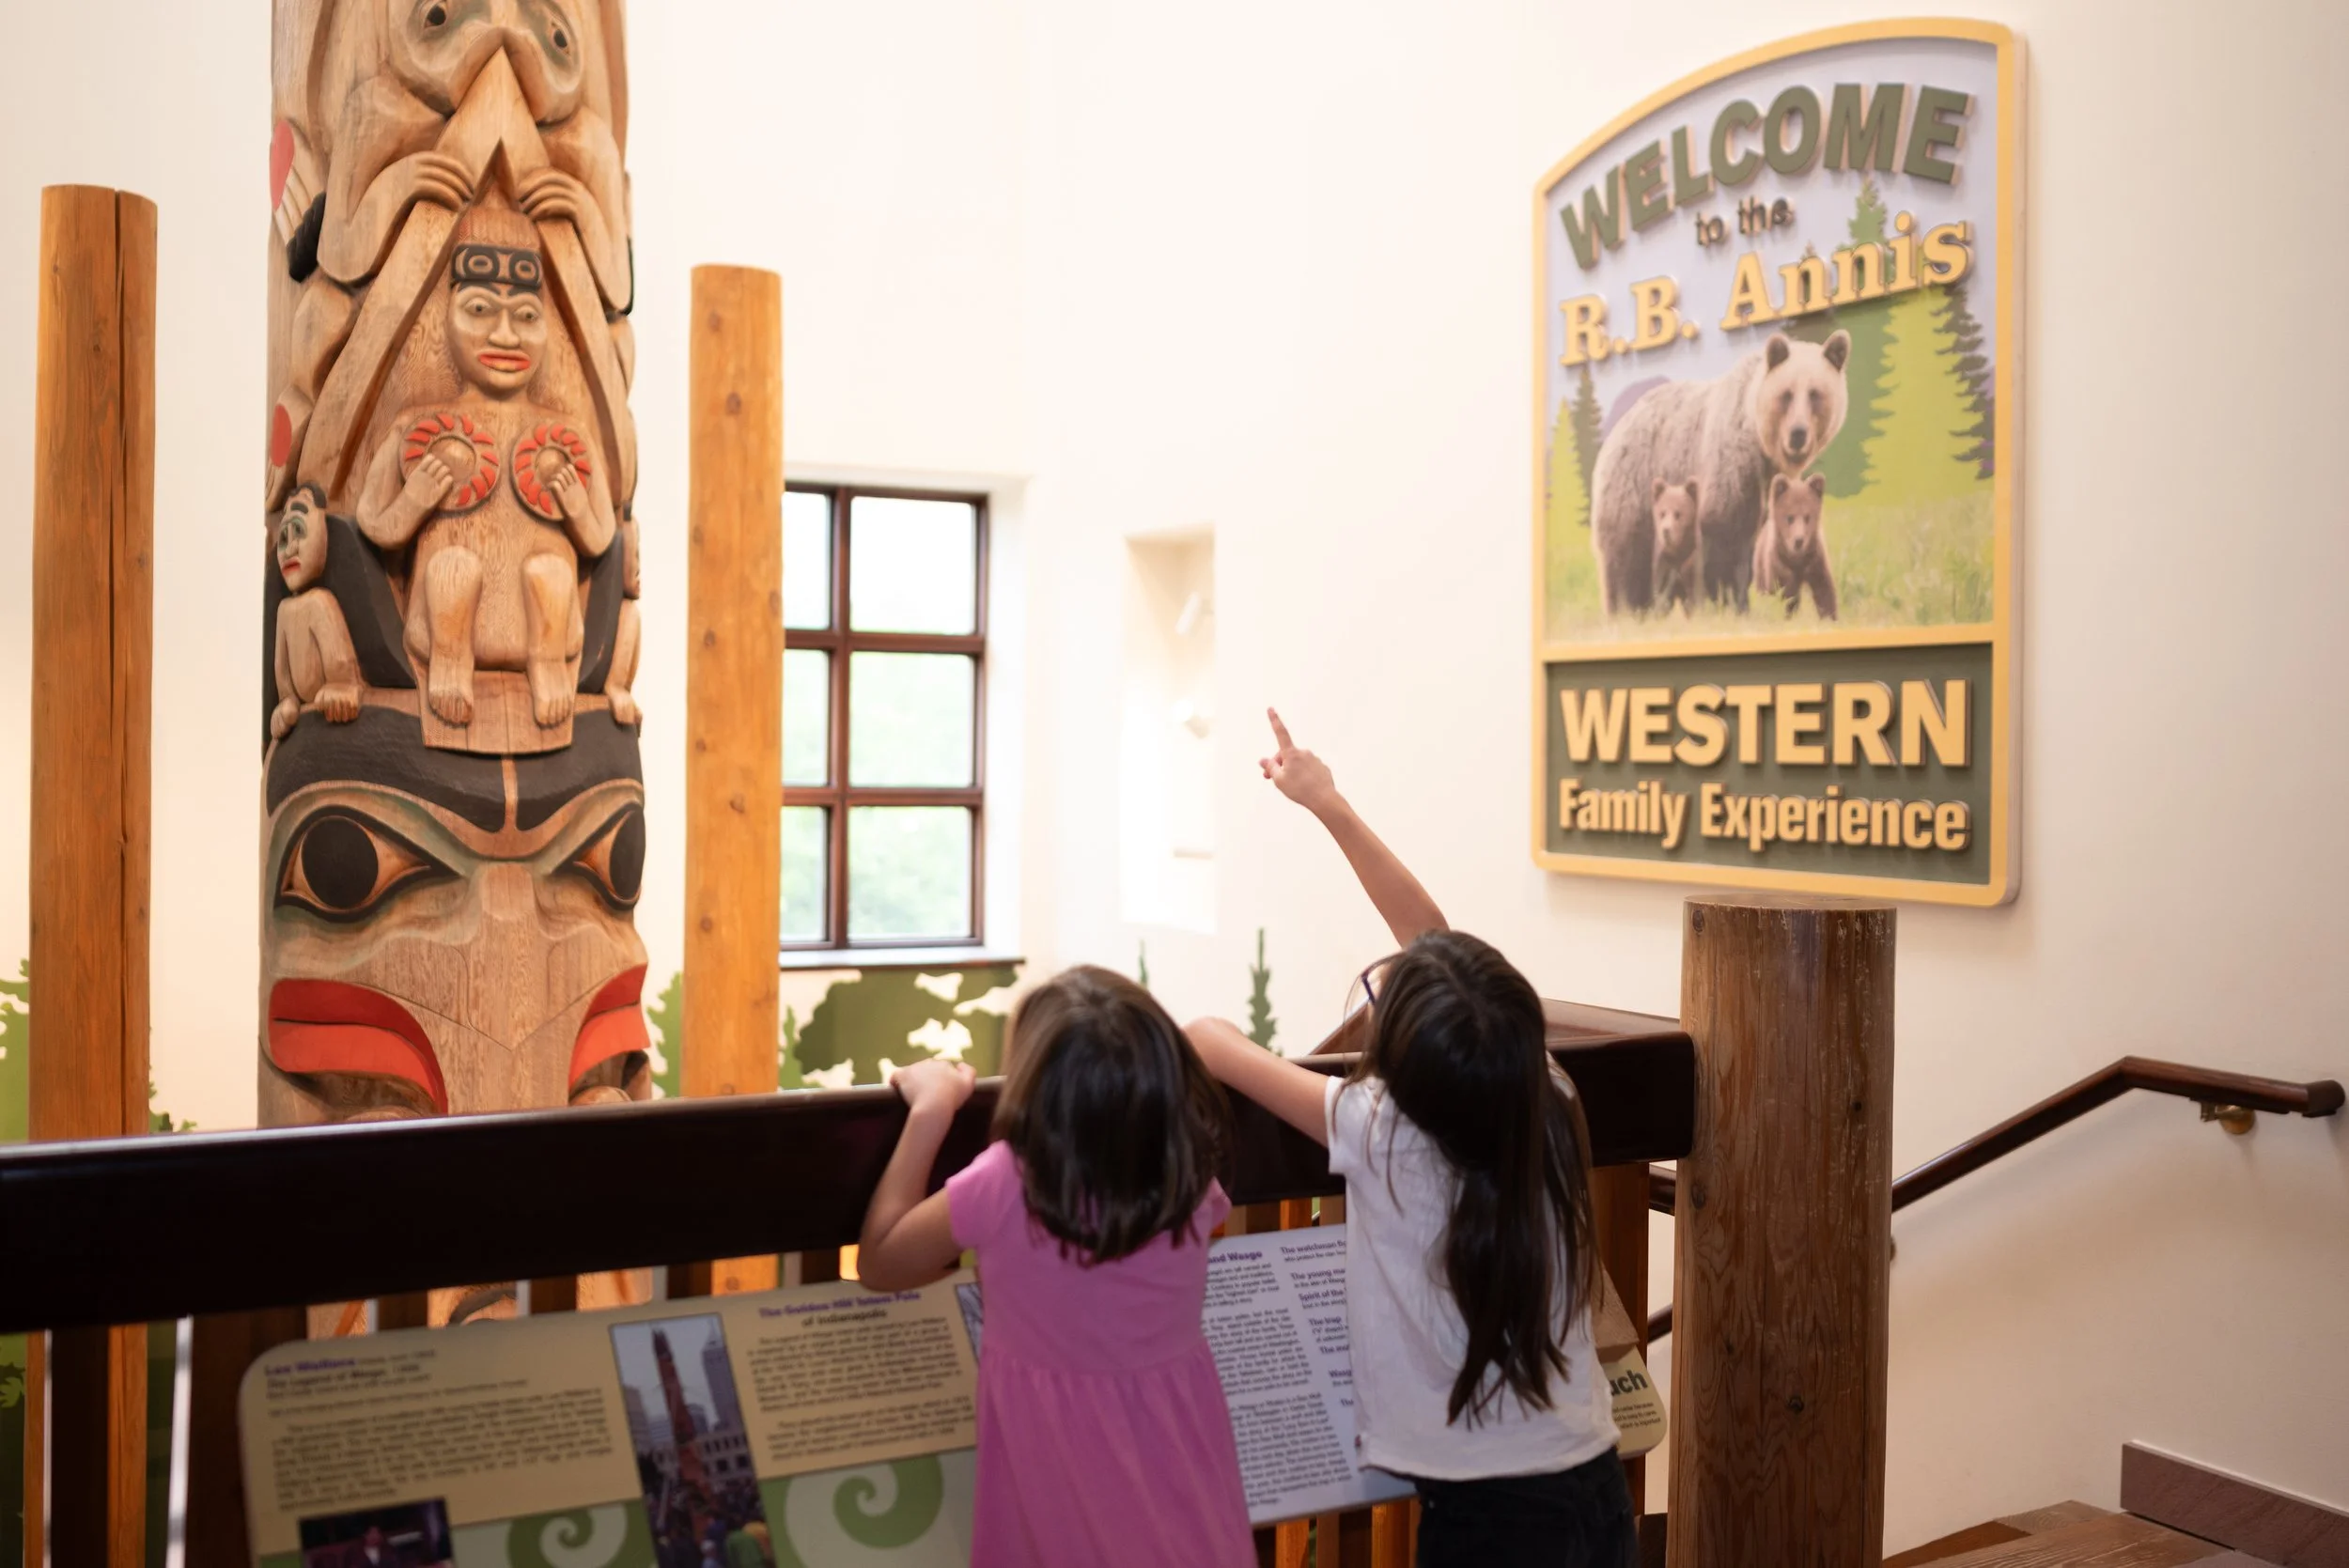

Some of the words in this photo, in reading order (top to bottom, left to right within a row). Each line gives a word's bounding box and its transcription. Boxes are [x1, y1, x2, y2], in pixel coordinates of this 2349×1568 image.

[1560, 82, 1977, 270] WELCOME
[1696, 211, 1726, 246] to
[1737, 196, 1794, 236] the
[1559, 275, 1699, 365] R.B.
[1720, 211, 1972, 331] Annis
[1560, 678, 1971, 767] WESTERN
[1559, 778, 1687, 849] Family
[1700, 782, 1970, 851] Experience
